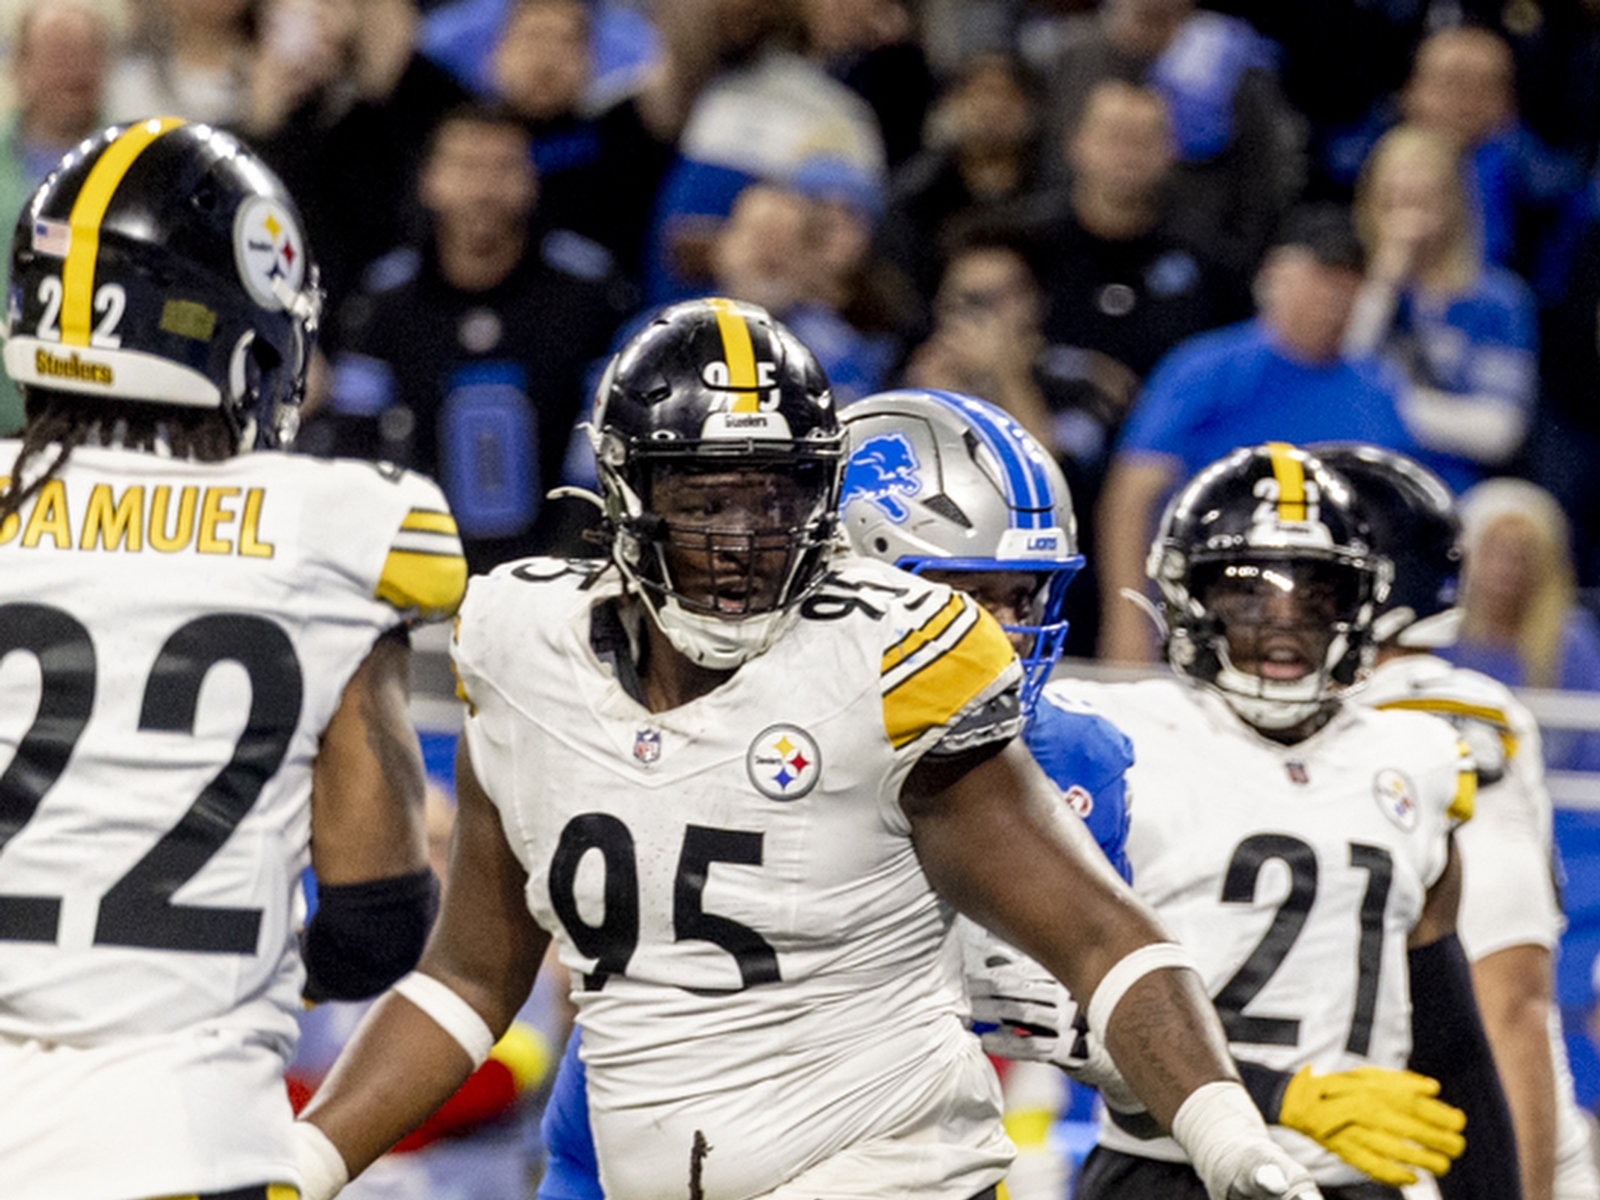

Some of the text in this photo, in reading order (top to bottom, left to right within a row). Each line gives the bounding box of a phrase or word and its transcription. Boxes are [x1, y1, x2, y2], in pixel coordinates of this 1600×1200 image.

[37, 275, 126, 349] 22
[34, 348, 113, 385] Steelers
[702, 361, 781, 413] 95
[1252, 476, 1321, 525] 21
[0, 601, 305, 956] 22
[547, 811, 783, 999] 95
[1212, 832, 1394, 1059] 21
